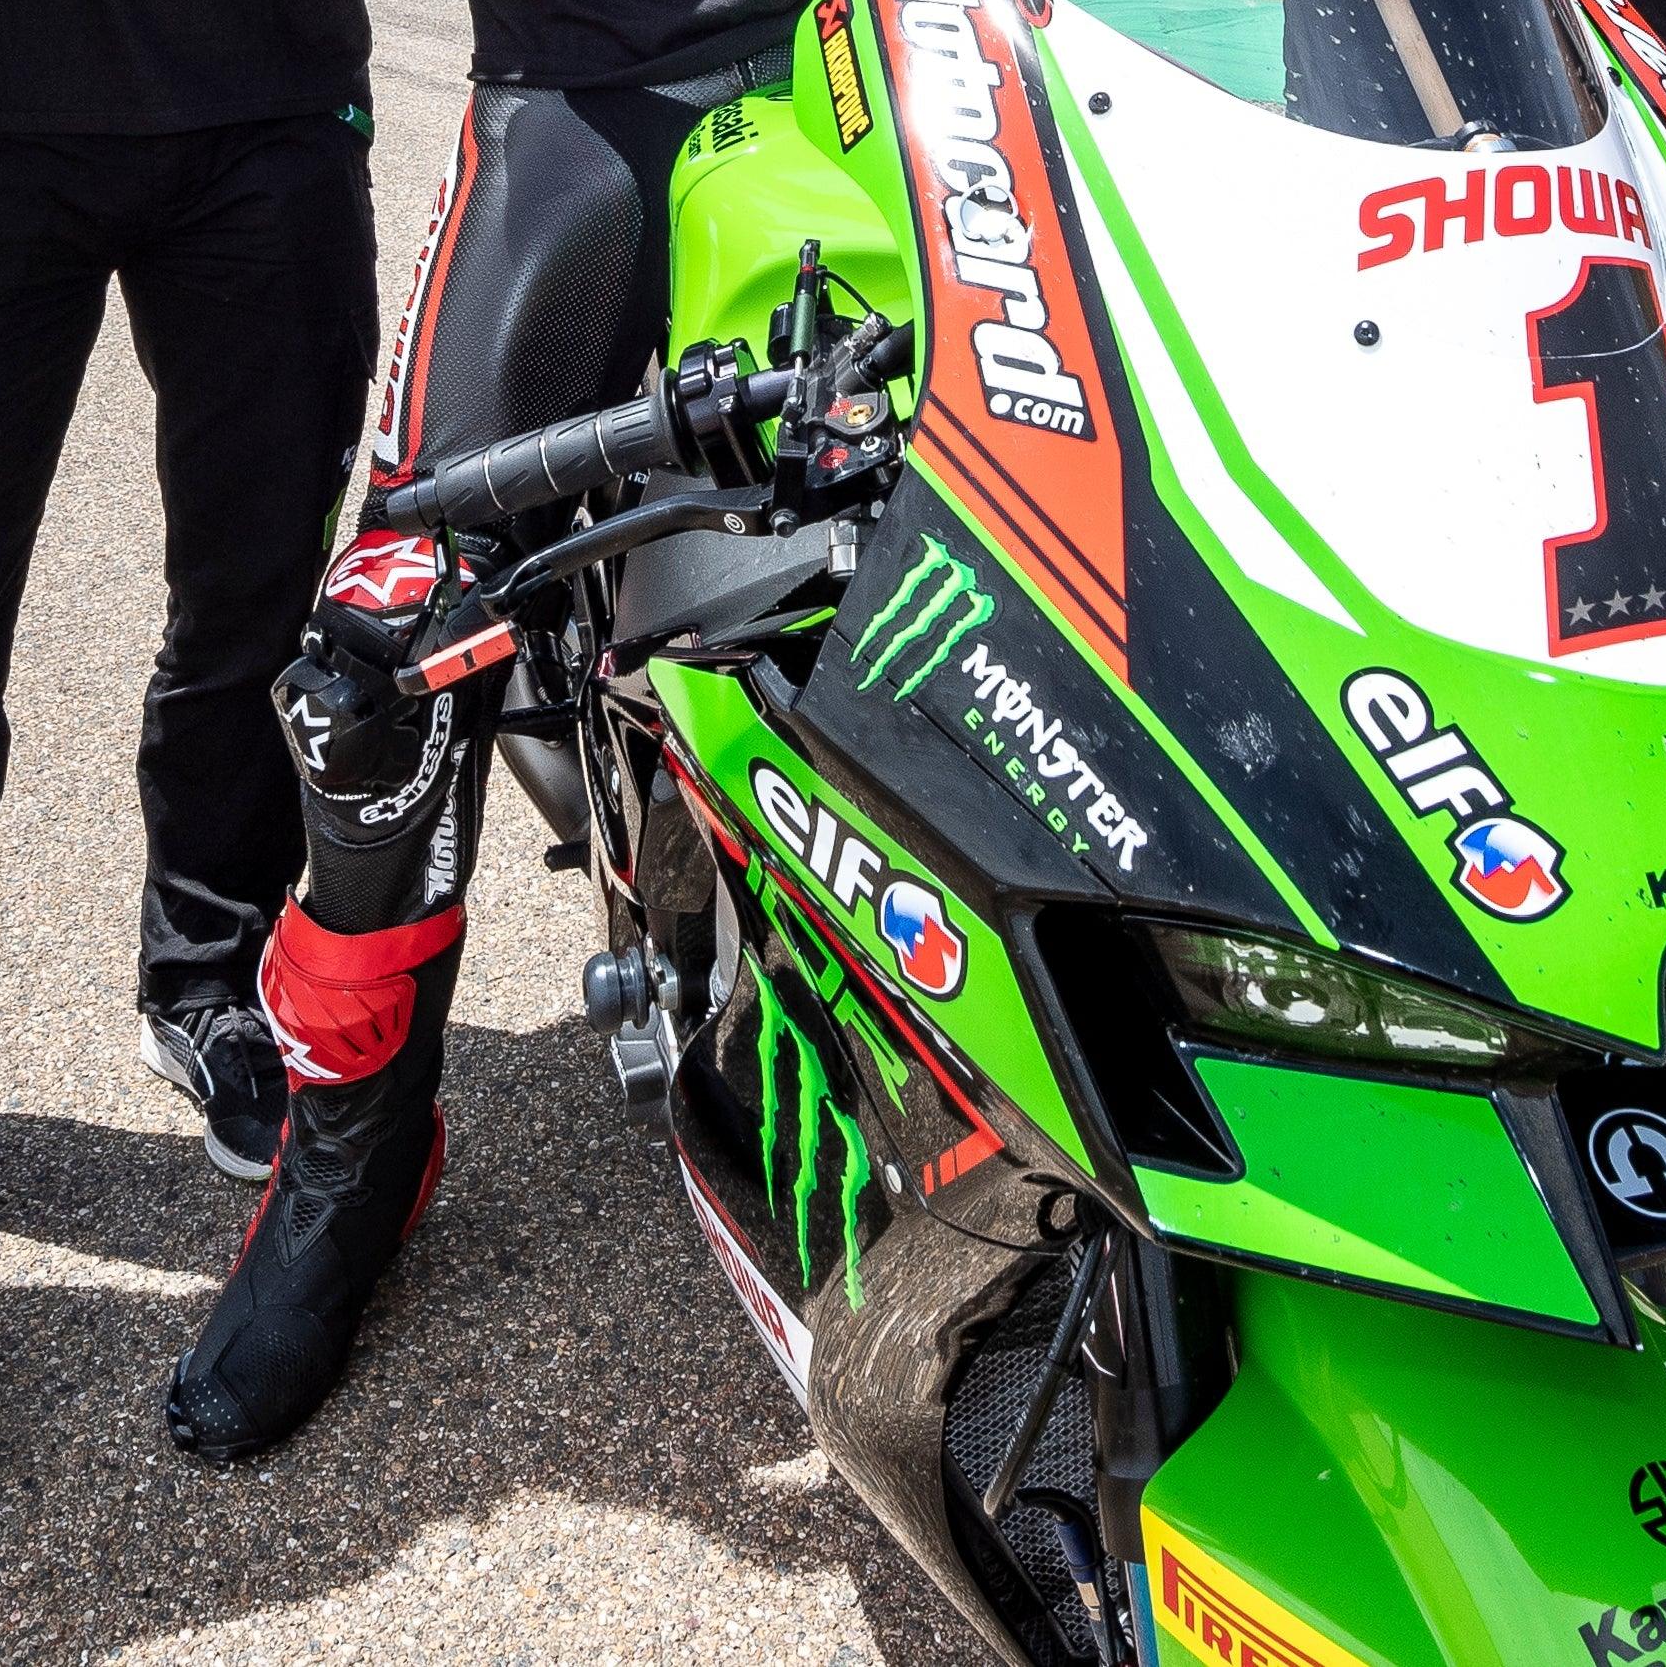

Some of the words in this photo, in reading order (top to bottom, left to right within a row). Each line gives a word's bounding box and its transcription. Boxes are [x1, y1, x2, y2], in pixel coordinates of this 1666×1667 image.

[1355, 163, 1653, 273] SHOWA
[961, 642, 1148, 872] MONSTER
[963, 707, 1091, 855] ENERGY
[1346, 672, 1505, 820] elf
[753, 766, 883, 908] elf
